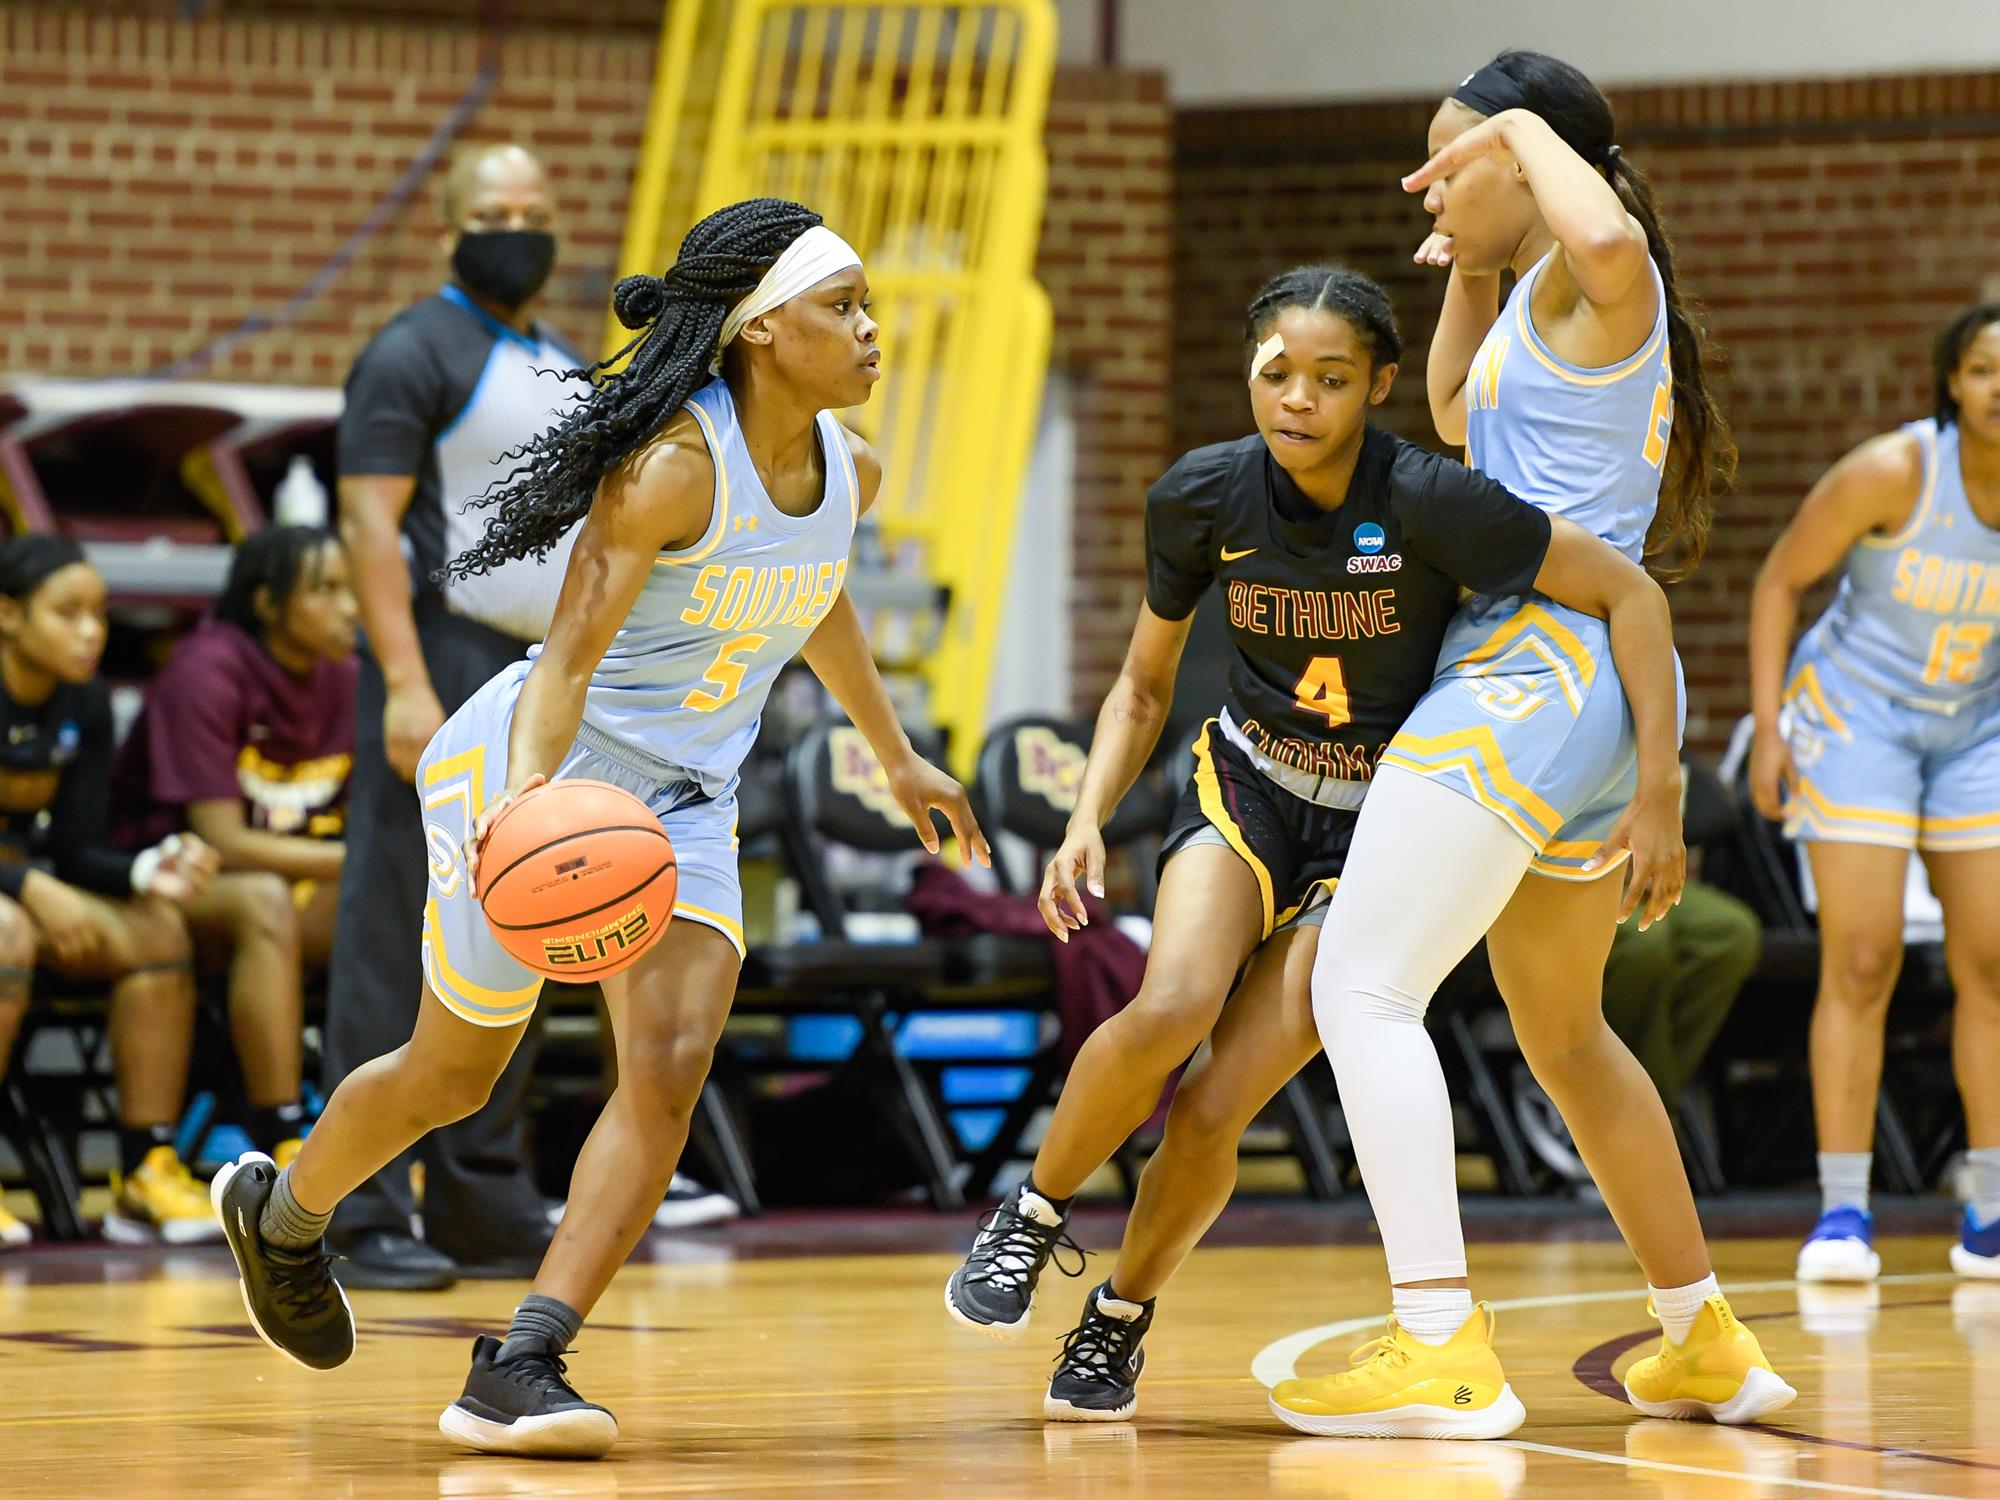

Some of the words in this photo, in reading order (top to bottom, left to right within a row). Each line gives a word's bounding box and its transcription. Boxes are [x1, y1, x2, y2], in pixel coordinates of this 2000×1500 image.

[1347, 554, 1402, 574] SWAC
[1358, 536, 1383, 546] NCAA
[1228, 580, 1401, 639] BETHUNE
[680, 632, 773, 713] 5
[1922, 620, 1994, 685] 12
[1293, 654, 1352, 728] 4
[543, 911, 650, 966] ELITE
